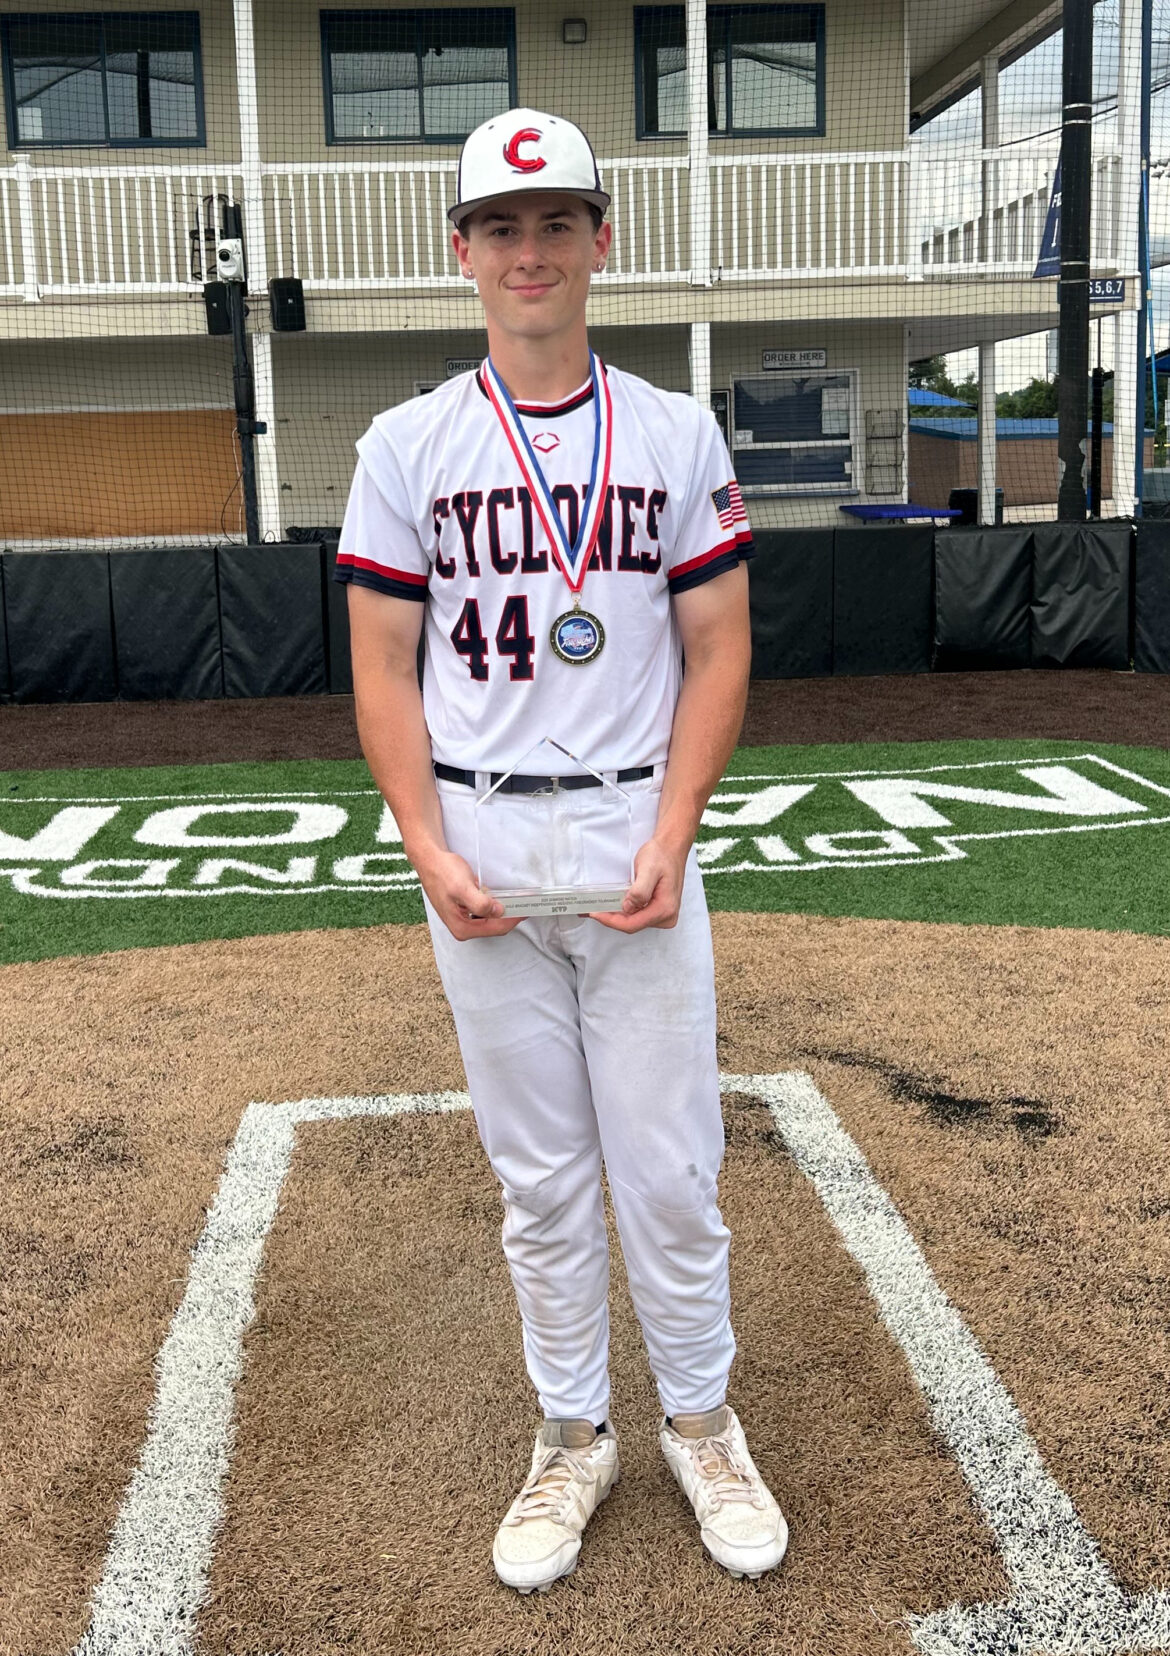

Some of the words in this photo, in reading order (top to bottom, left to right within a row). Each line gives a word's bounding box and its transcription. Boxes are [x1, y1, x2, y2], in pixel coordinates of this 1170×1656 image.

[503, 127, 547, 174] C
[448, 361, 480, 371] ORDER
[764, 353, 796, 362] ORDER
[800, 352, 825, 361] HERE
[433, 484, 668, 580] CYCLONES
[450, 595, 535, 681] 44
